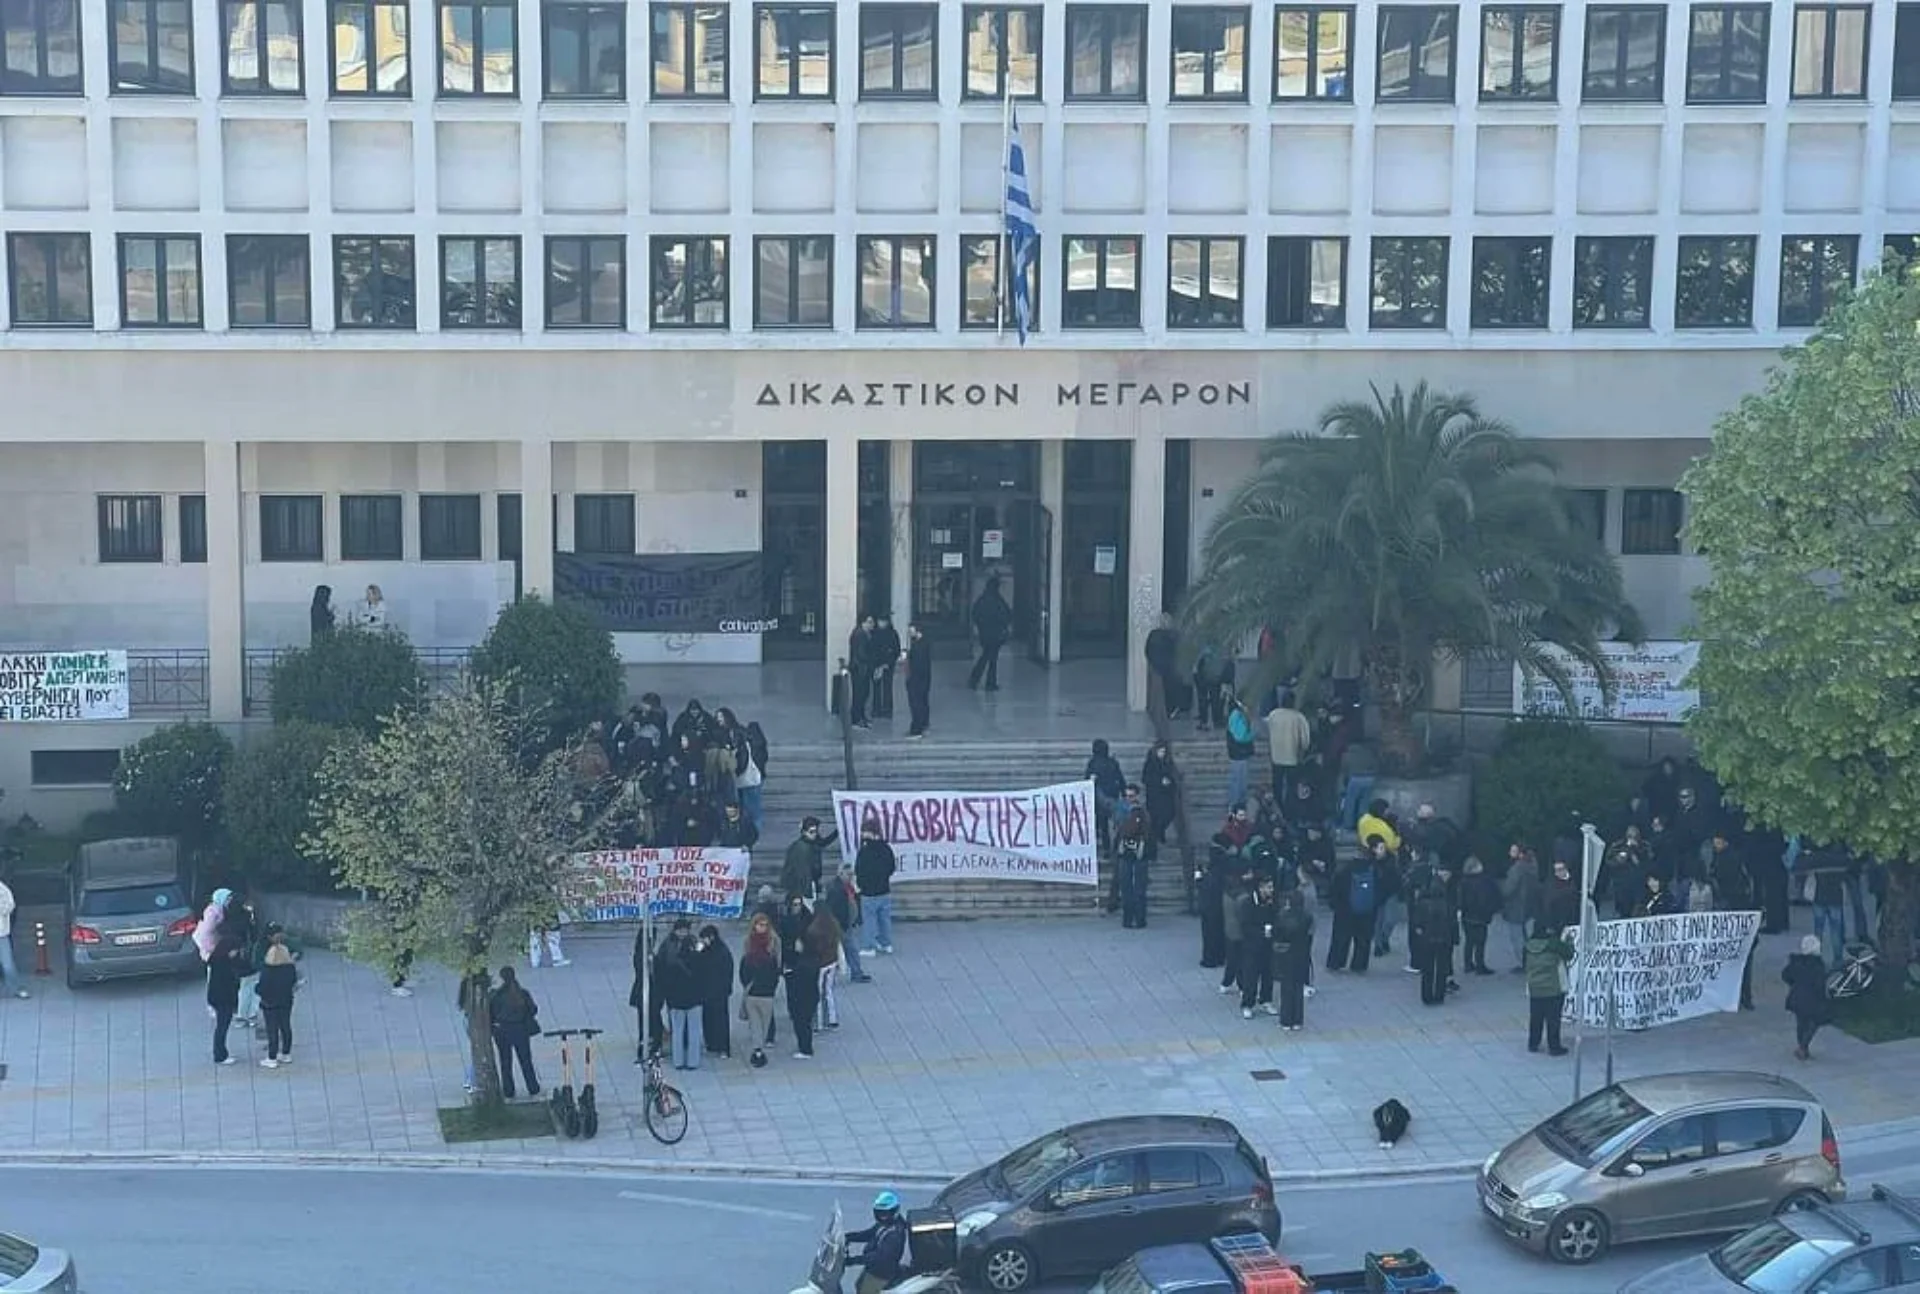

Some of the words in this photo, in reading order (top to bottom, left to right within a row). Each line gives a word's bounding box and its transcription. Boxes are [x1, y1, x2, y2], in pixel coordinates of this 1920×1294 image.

[755, 382, 1019, 406] ΔΙΚΑΣΤΙΚΟΝ
[1057, 382, 1250, 406] ΜΕΓΑΡΟΝ
[86, 688, 112, 707] ΠΟΥ
[840, 798, 1029, 853] ΠΑΙΔΟΒΙΑΣΤΗΣ
[1032, 791, 1090, 847] ΕΙΝΑΙ
[916, 852, 947, 871] ΤΗΝ
